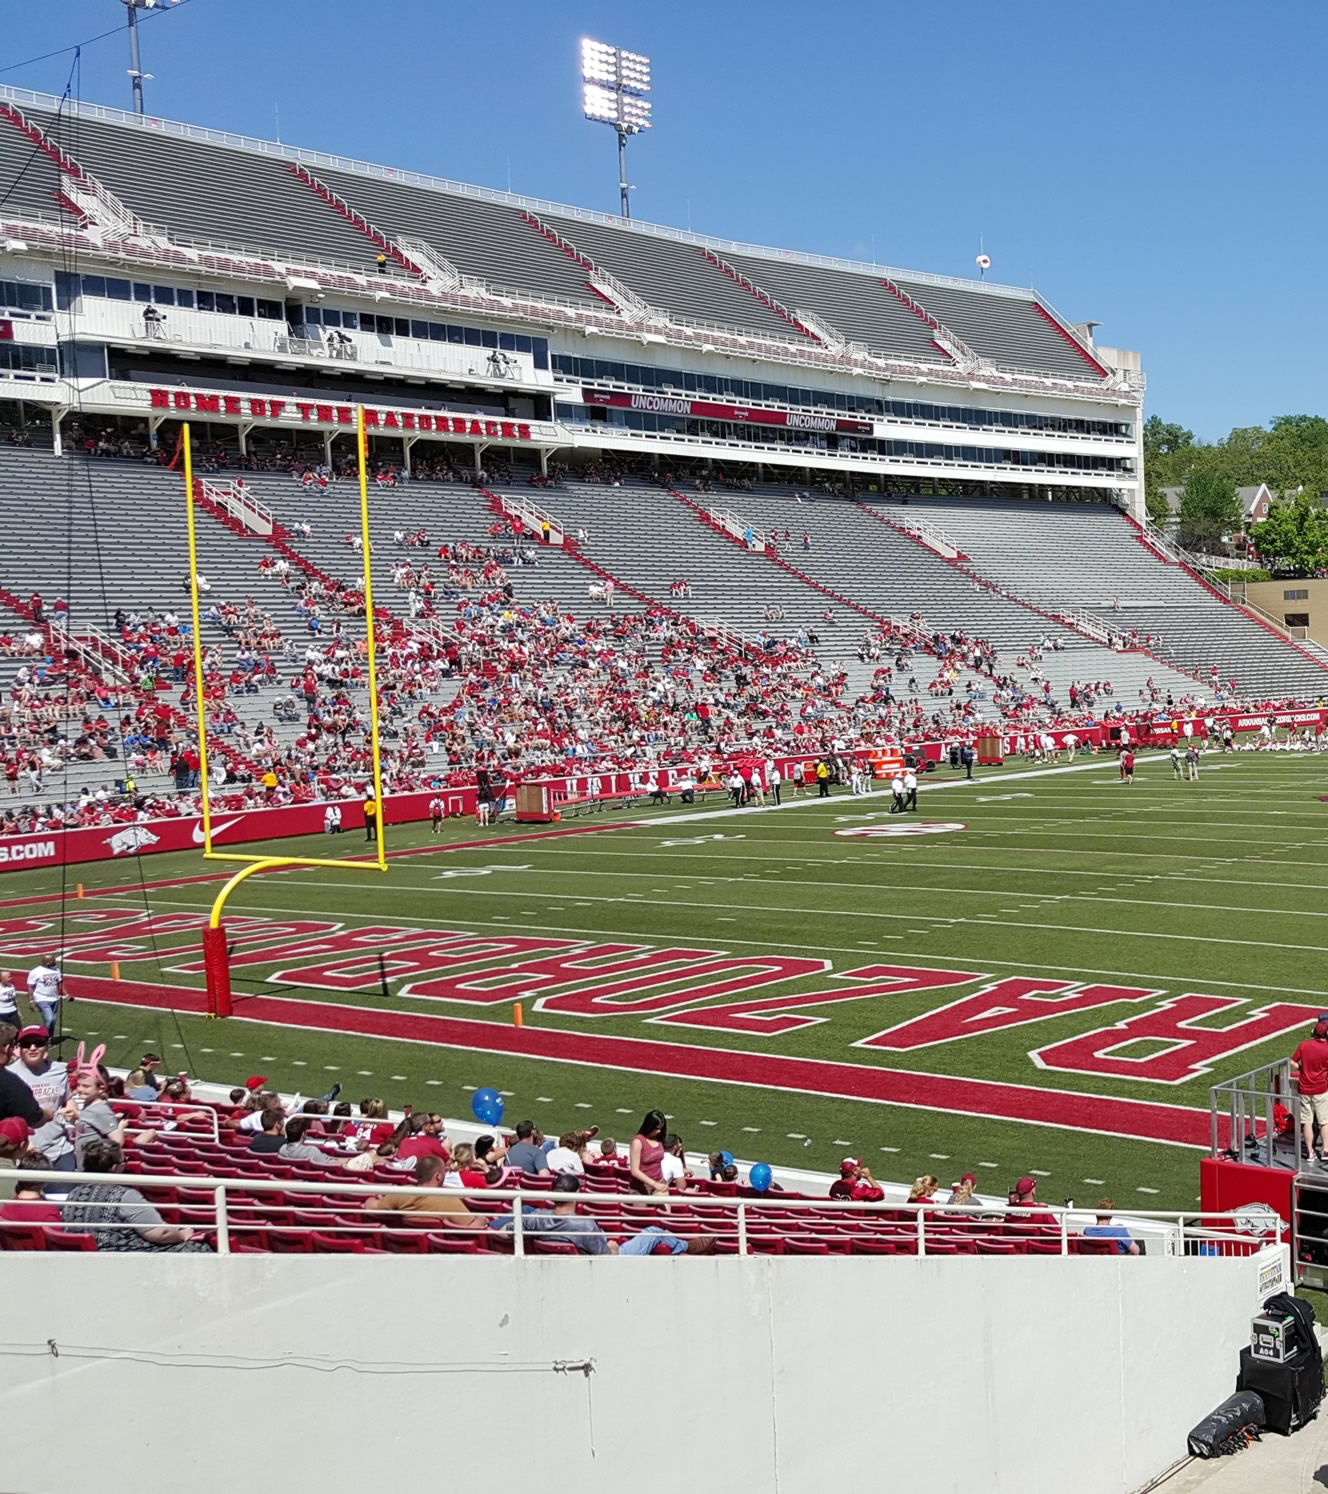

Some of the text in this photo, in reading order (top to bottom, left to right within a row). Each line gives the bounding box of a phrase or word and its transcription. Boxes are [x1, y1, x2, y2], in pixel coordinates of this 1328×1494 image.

[149, 388, 532, 439] HOME OF THE RAZORBACKS
[631, 394, 692, 415] UNCOMMON
[786, 413, 837, 432] UNCOMMON
[356, 1128, 372, 1140] 64
[1259, 1347, 1274, 1357] A04
